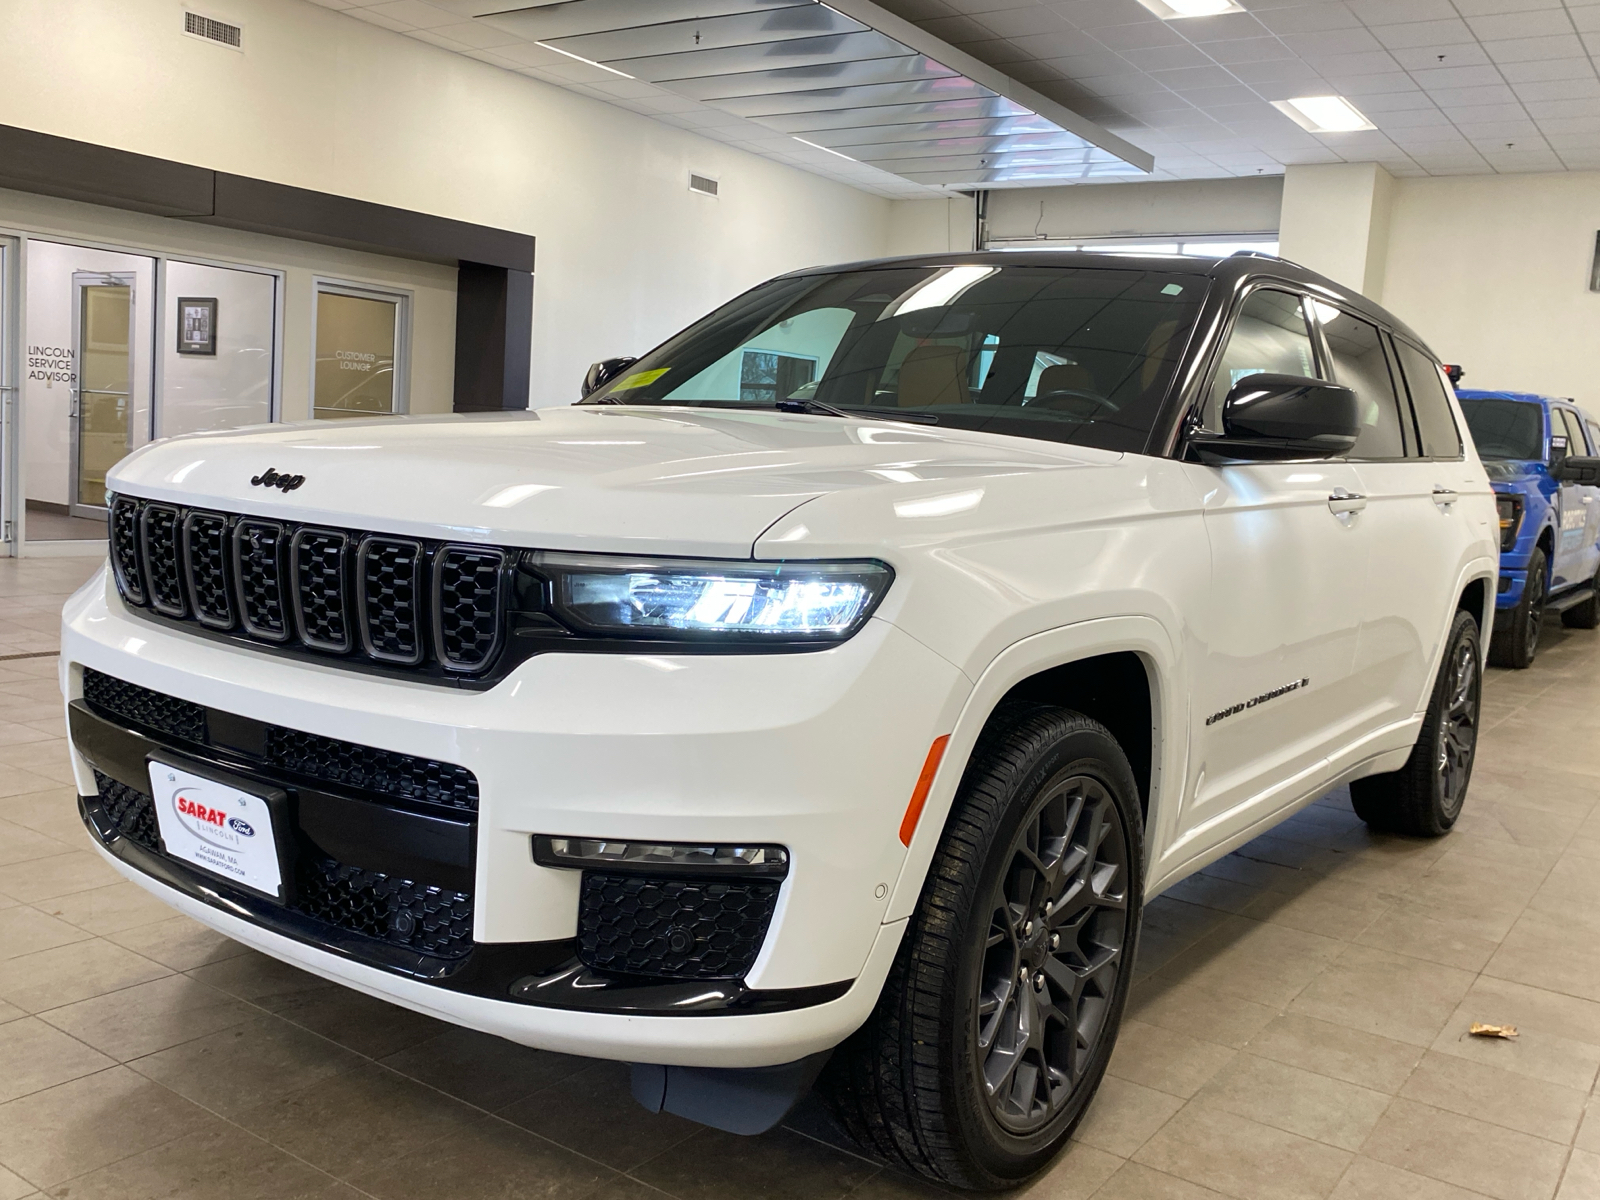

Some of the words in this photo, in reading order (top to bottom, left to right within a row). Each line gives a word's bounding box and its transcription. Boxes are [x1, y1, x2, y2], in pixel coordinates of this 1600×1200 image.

[28, 345, 75, 359] LINCOLN
[336, 350, 375, 362] CUSTOMER
[28, 357, 71, 370] SERVICE
[340, 361, 371, 371] LOUNGE
[28, 370, 77, 383] ADVISOR
[250, 467, 306, 494] Jeep
[1205, 702, 1245, 726] GRAND
[178, 797, 226, 827] SARAT
[231, 819, 253, 836] Ford
[201, 824, 233, 841] LINCOLN
[199, 845, 227, 862] AGAWAM,
[228, 855, 237, 865] MA
[195, 852, 245, 876] WWW.SARATFORD.COM
